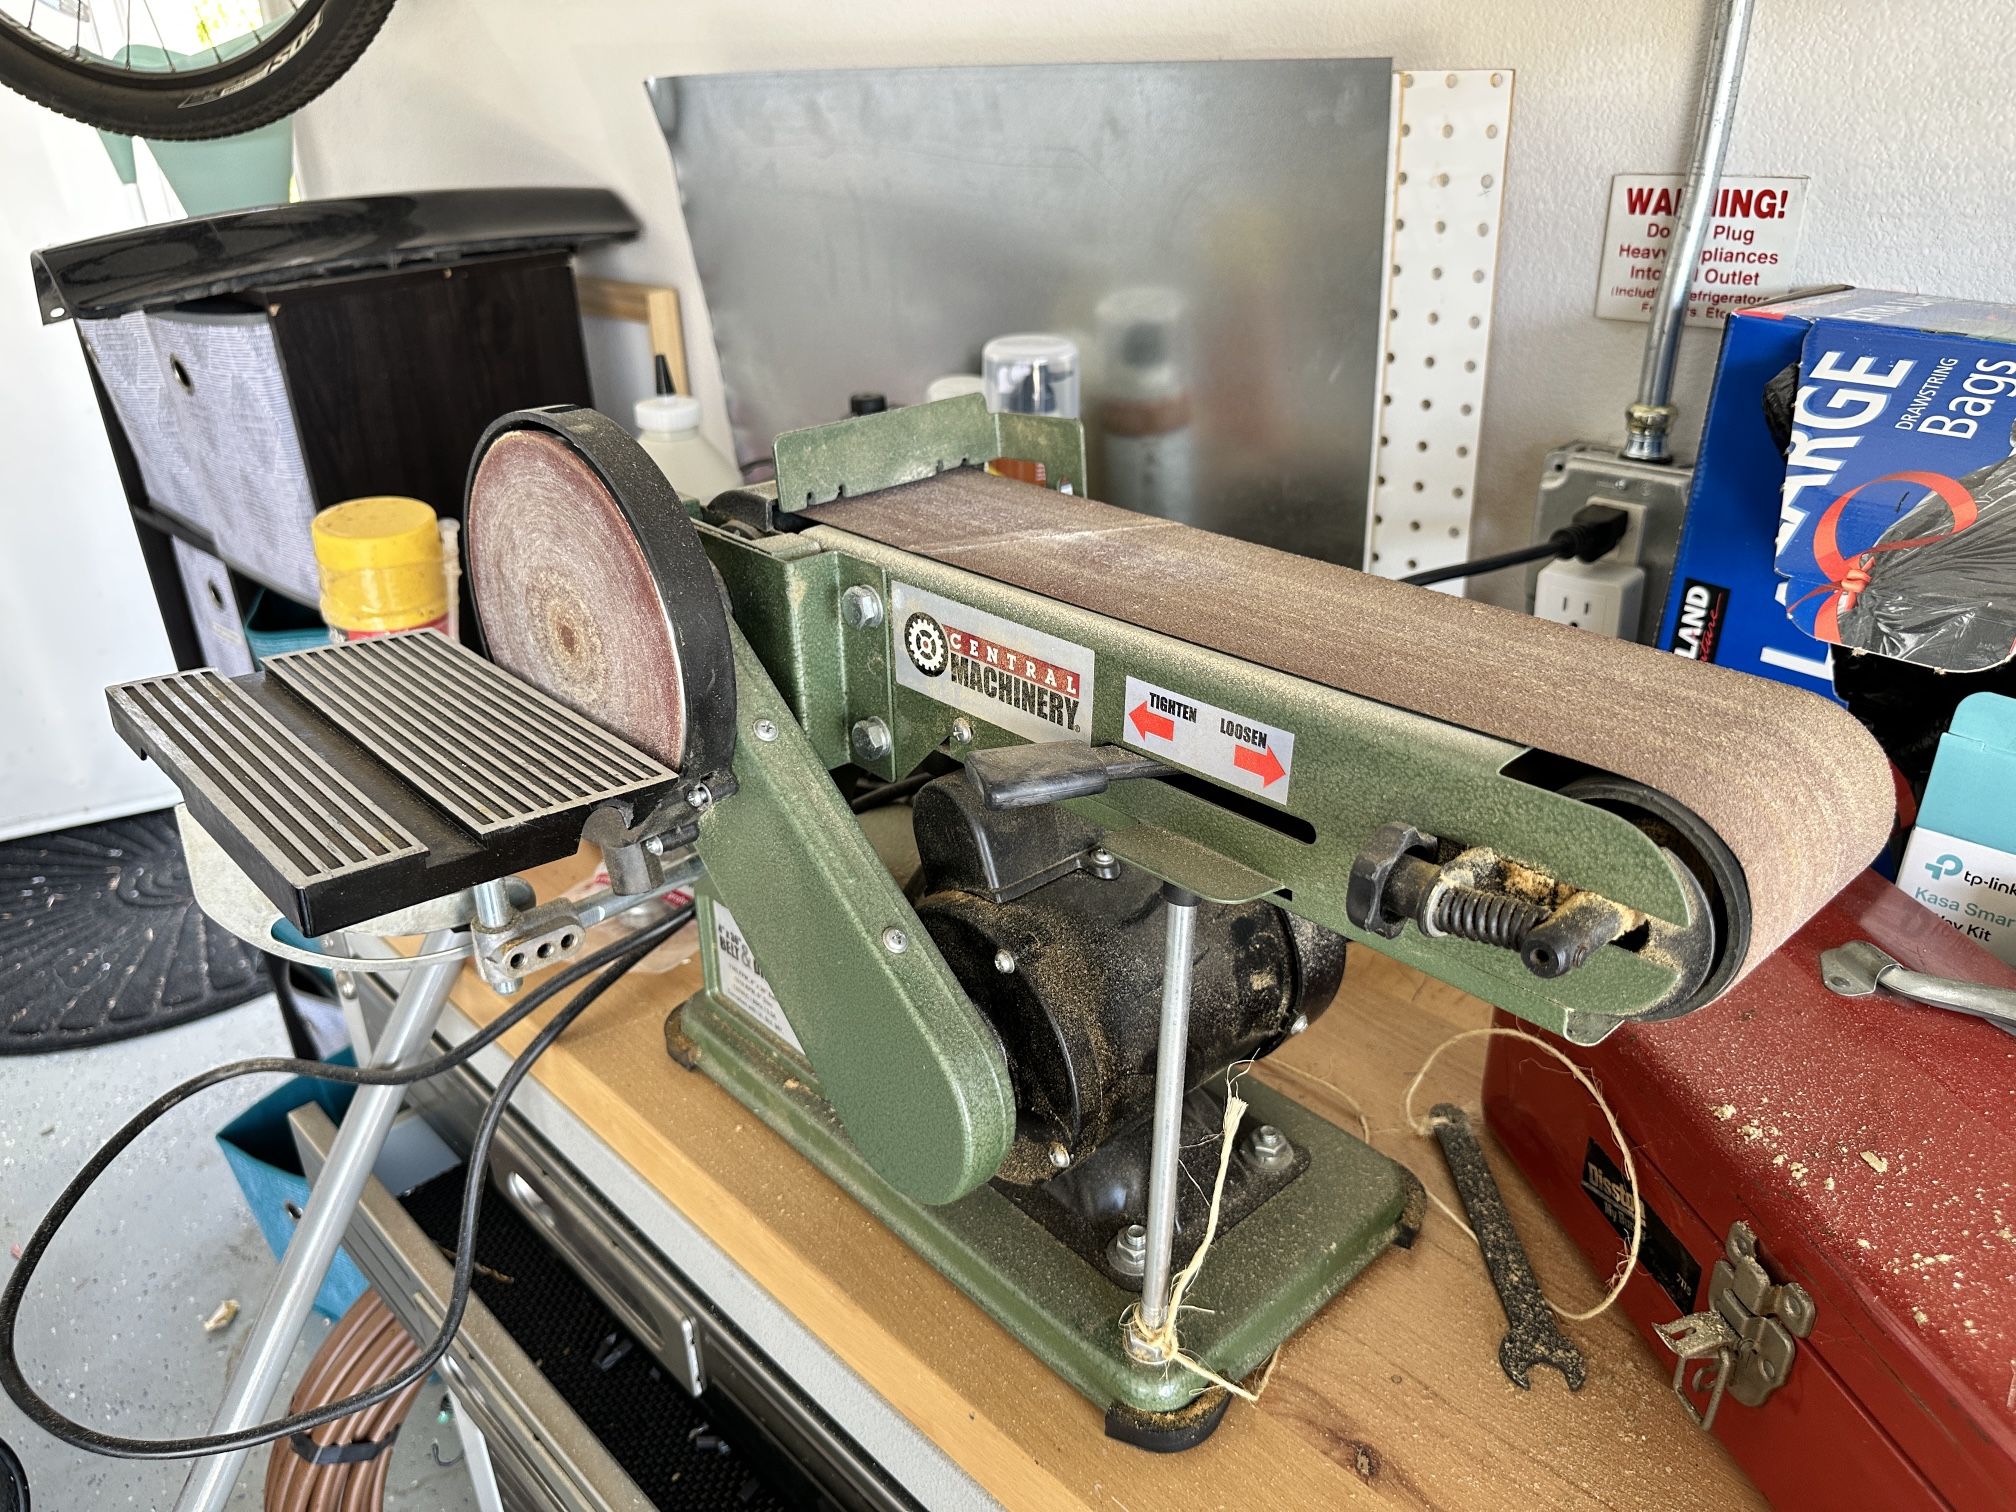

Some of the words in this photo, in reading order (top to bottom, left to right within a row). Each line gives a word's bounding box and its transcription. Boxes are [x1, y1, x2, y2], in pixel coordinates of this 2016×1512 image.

[1627, 187, 1788, 219] WAING!
[1647, 223, 1670, 238] Do
[1713, 225, 1754, 245] Plug
[1701, 248, 1778, 265] pliances
[1704, 268, 1759, 286] Outlet
[1894, 358, 1959, 430] DRAWSTRING
[1917, 359, 2016, 439] Bags
[950, 633, 1077, 694] CENTRAL
[1149, 692, 1197, 723] TIGHTEN
[1220, 718, 1267, 749] LOOSEN
[1915, 886, 1960, 911] Kasa
[1965, 902, 2016, 928] Smar
[1967, 924, 1991, 941] Kit
[720, 934, 739, 960] BELT
[742, 944, 753, 969] &
